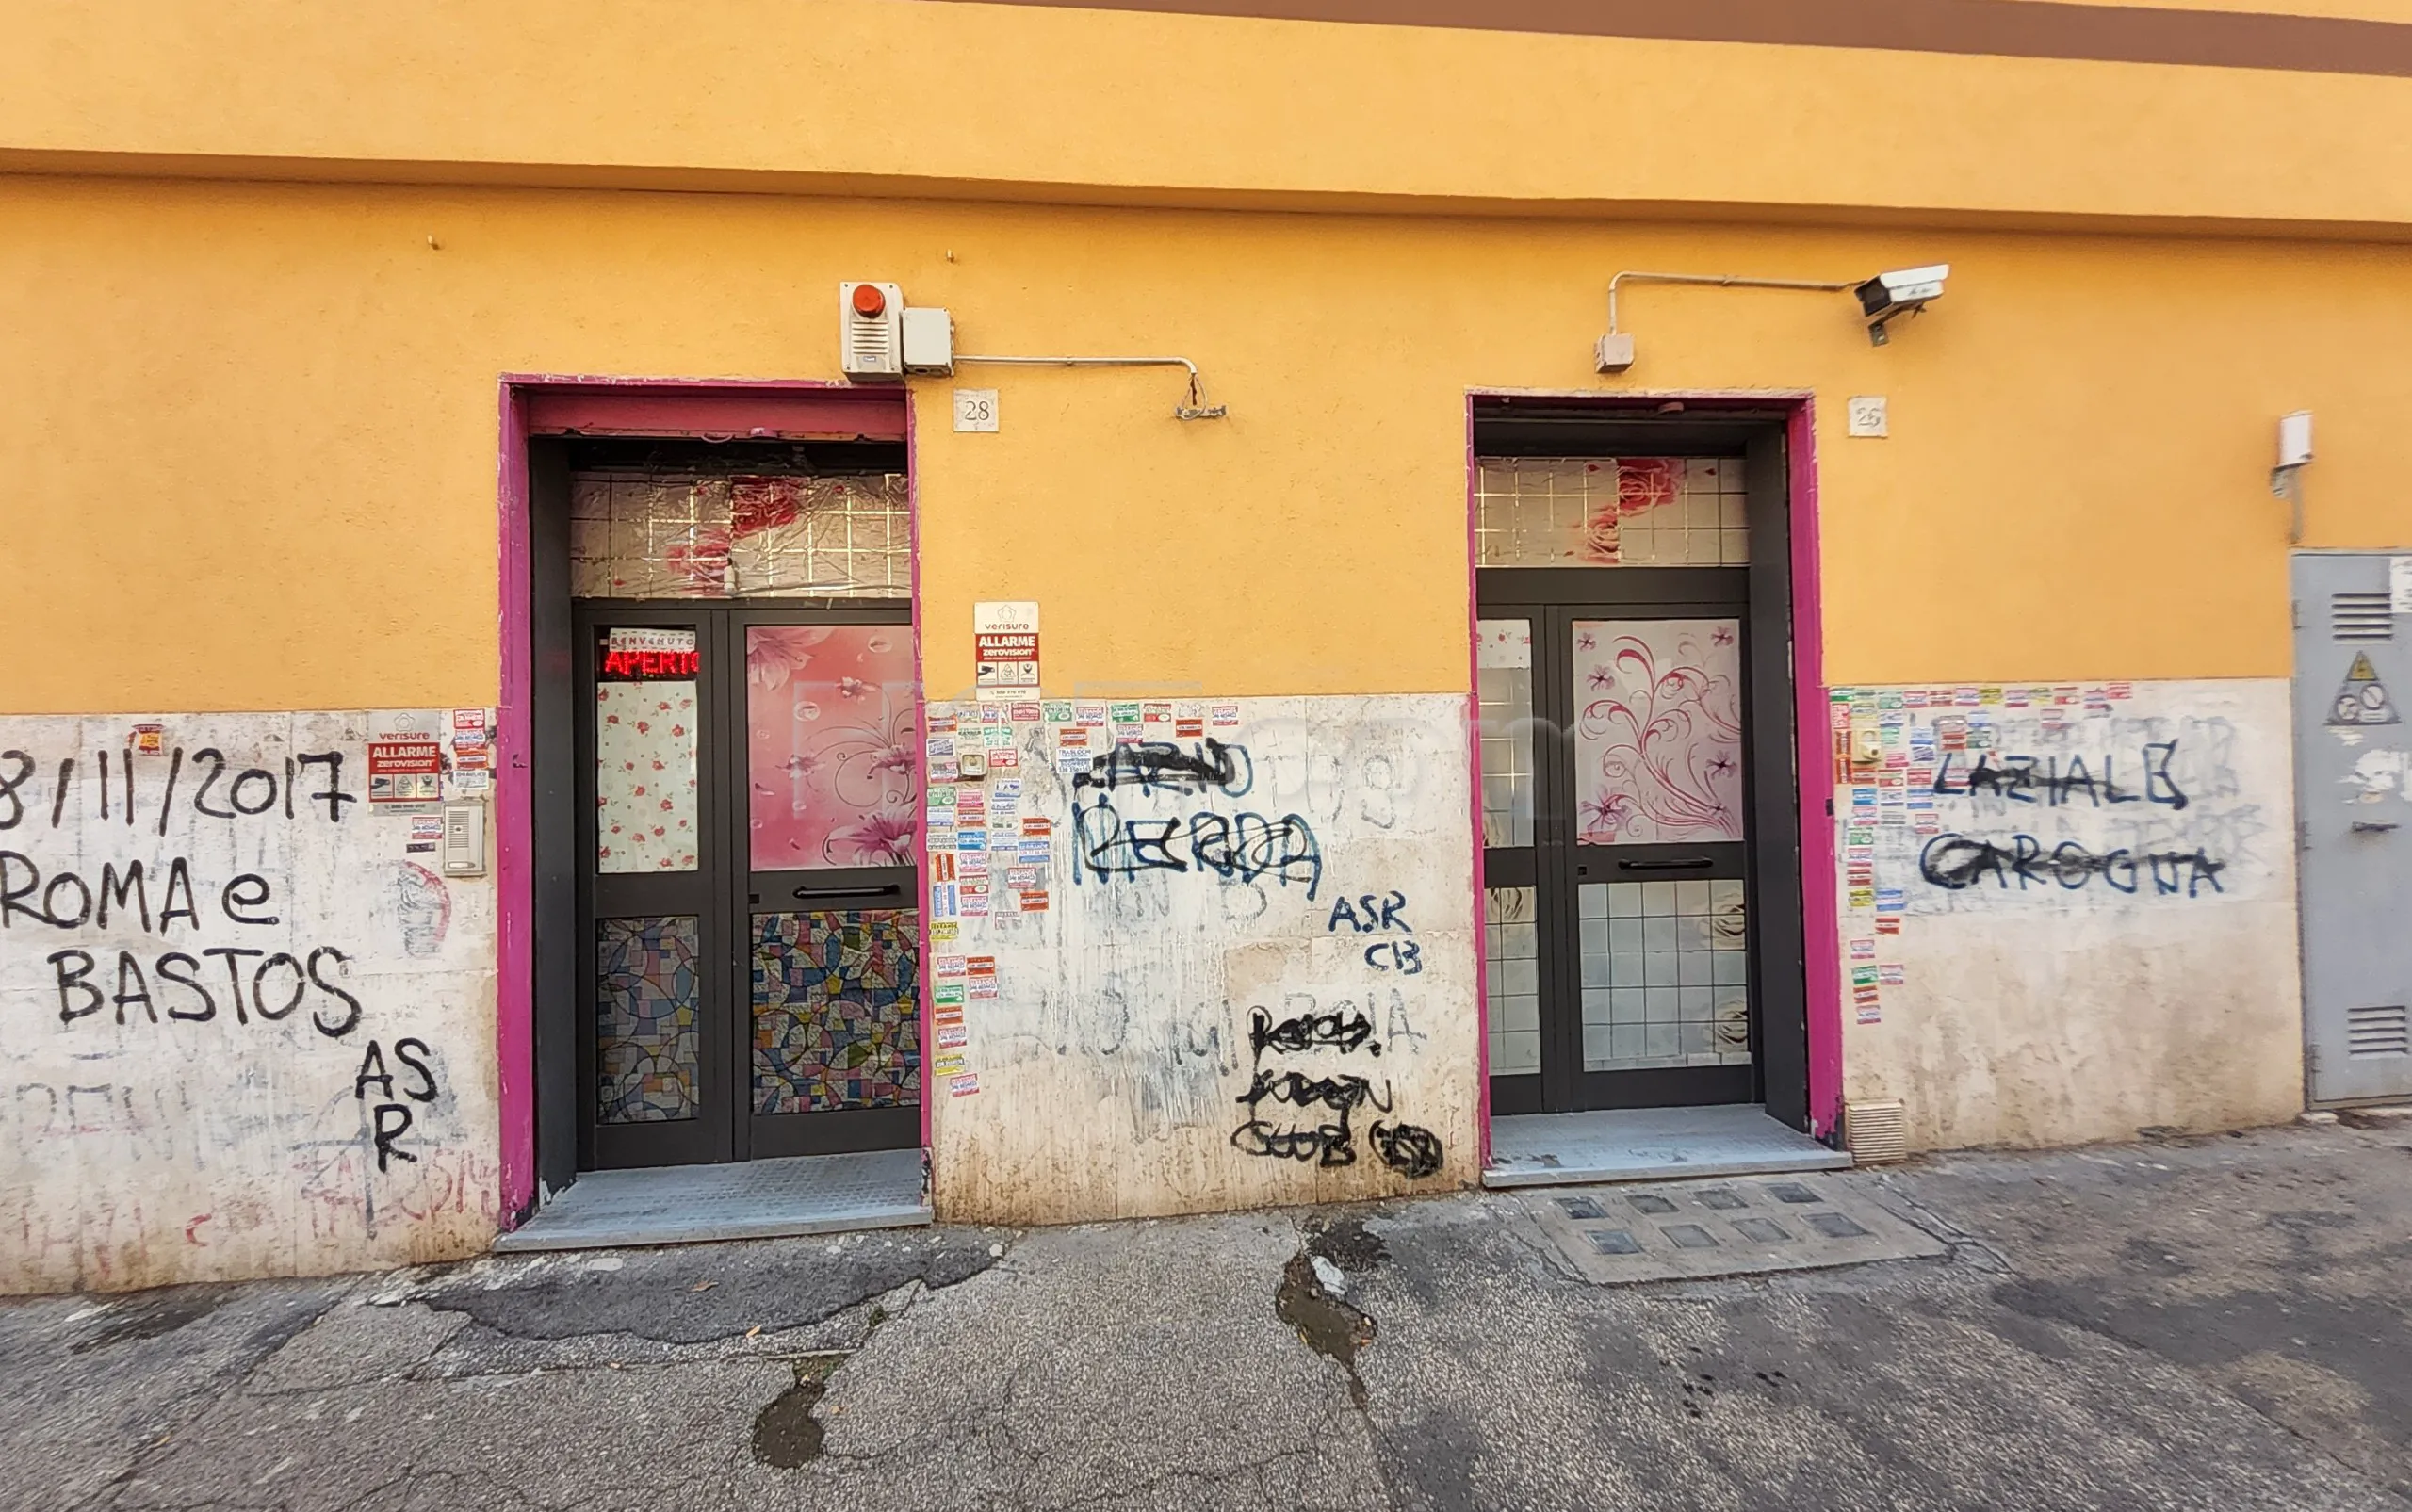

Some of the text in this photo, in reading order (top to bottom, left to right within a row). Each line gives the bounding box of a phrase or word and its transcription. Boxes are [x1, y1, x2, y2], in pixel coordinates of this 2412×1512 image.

[964, 400, 990, 421] 28
[978, 635, 1035, 647] ALLARME
[372, 745, 437, 758] ALLARME
[379, 732, 431, 740] verisure
[0, 851, 280, 934] ROMA e
[1328, 890, 1413, 934] ASR
[47, 946, 364, 1038] BASTOS
[355, 1037, 440, 1102] AS
[373, 1103, 418, 1174] R
